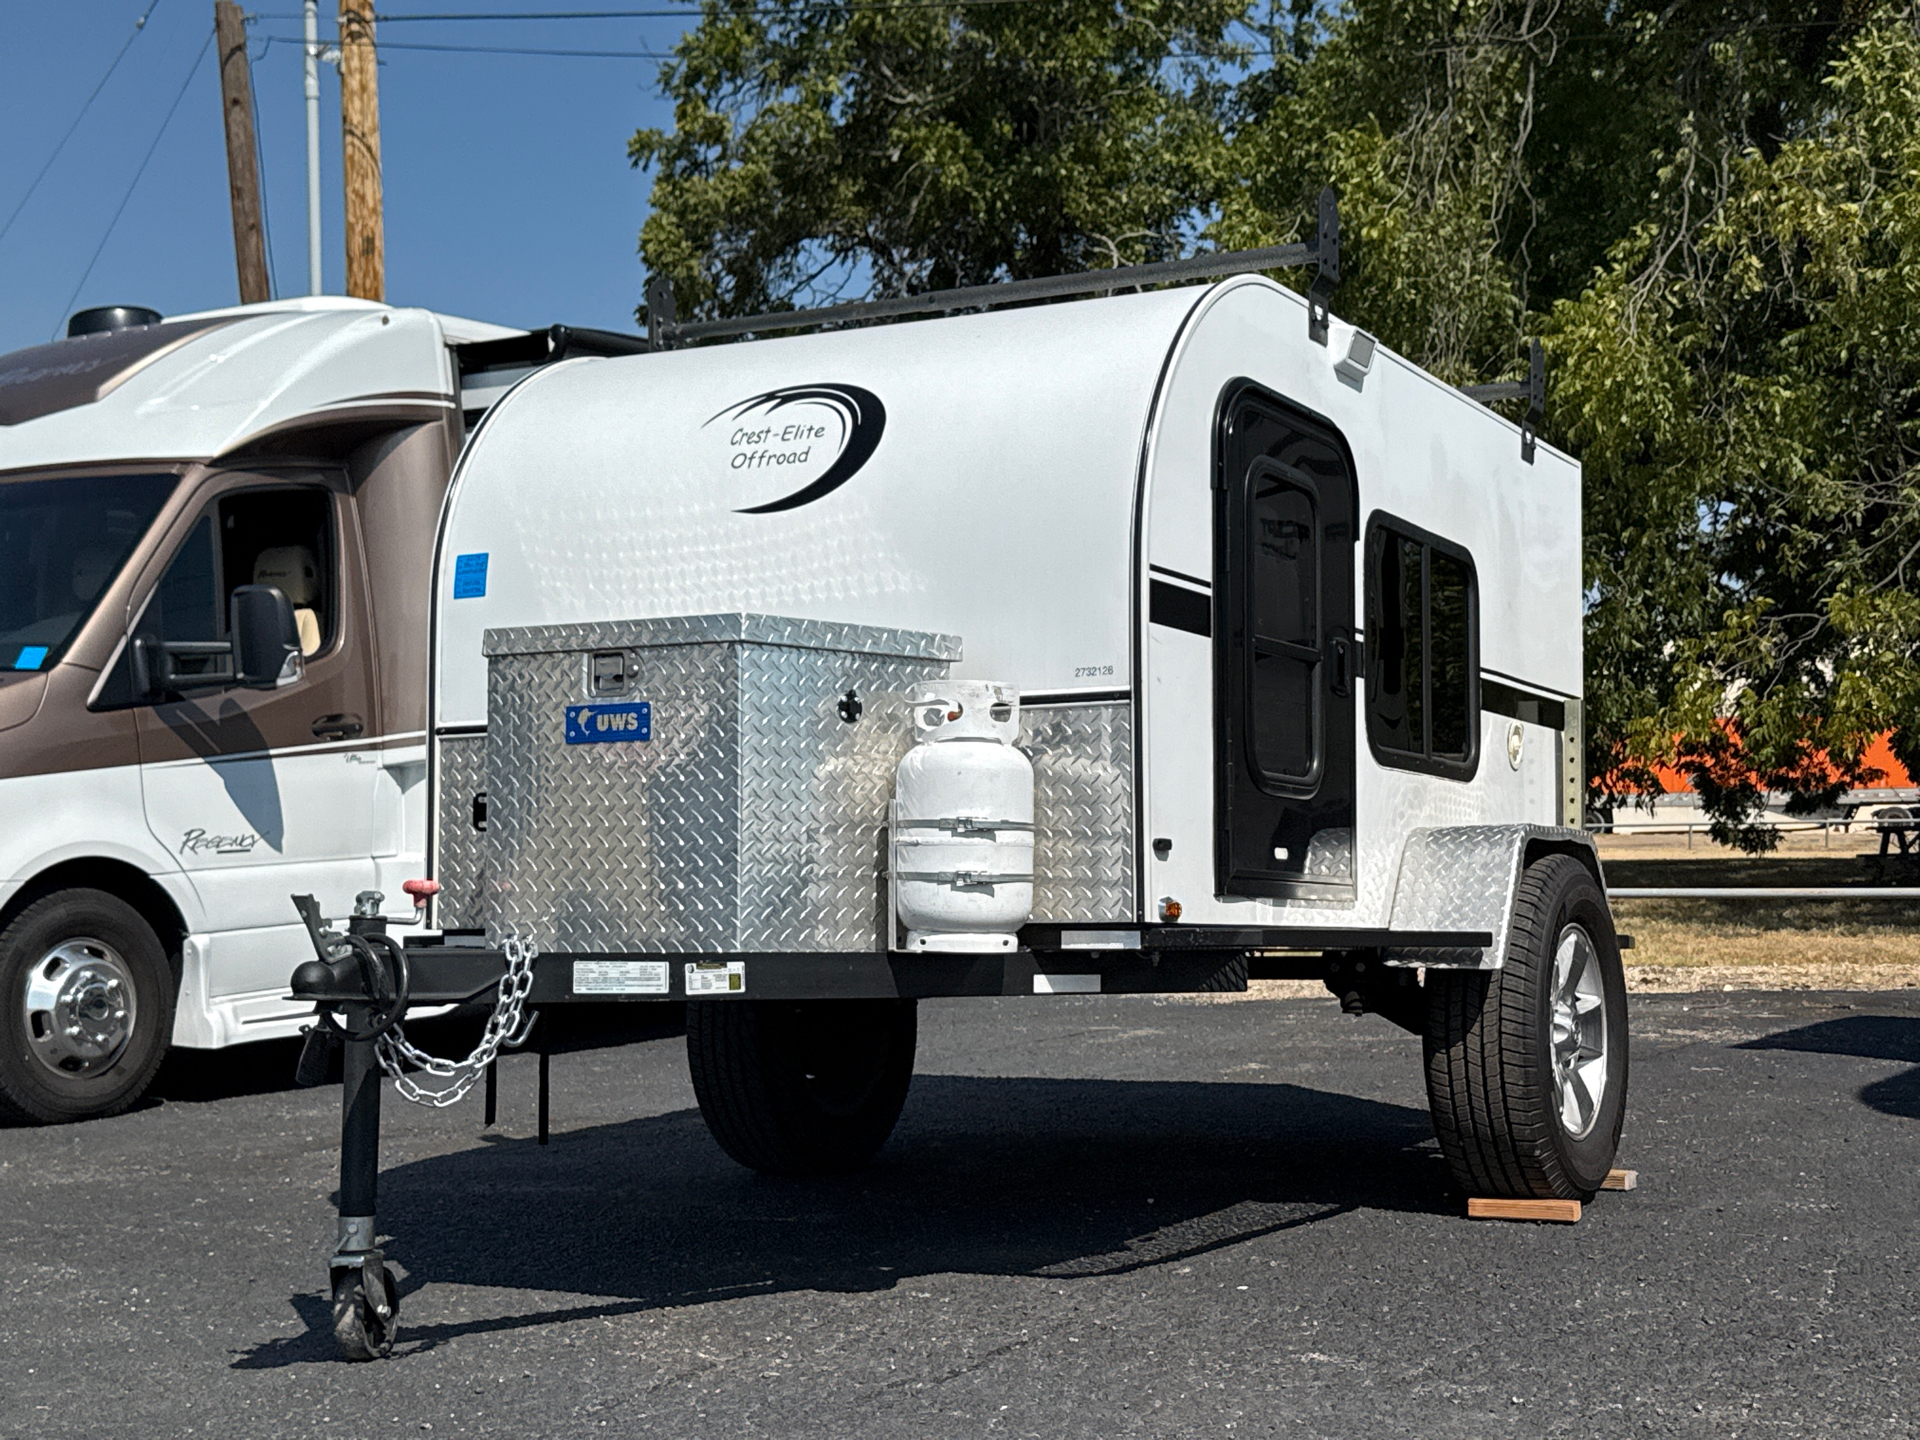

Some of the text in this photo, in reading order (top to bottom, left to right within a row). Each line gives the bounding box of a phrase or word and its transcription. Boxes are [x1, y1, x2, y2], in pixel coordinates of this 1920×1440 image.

[730, 424, 826, 446] Crest-Elite
[730, 446, 812, 470] Offroad
[596, 712, 639, 732] UWS
